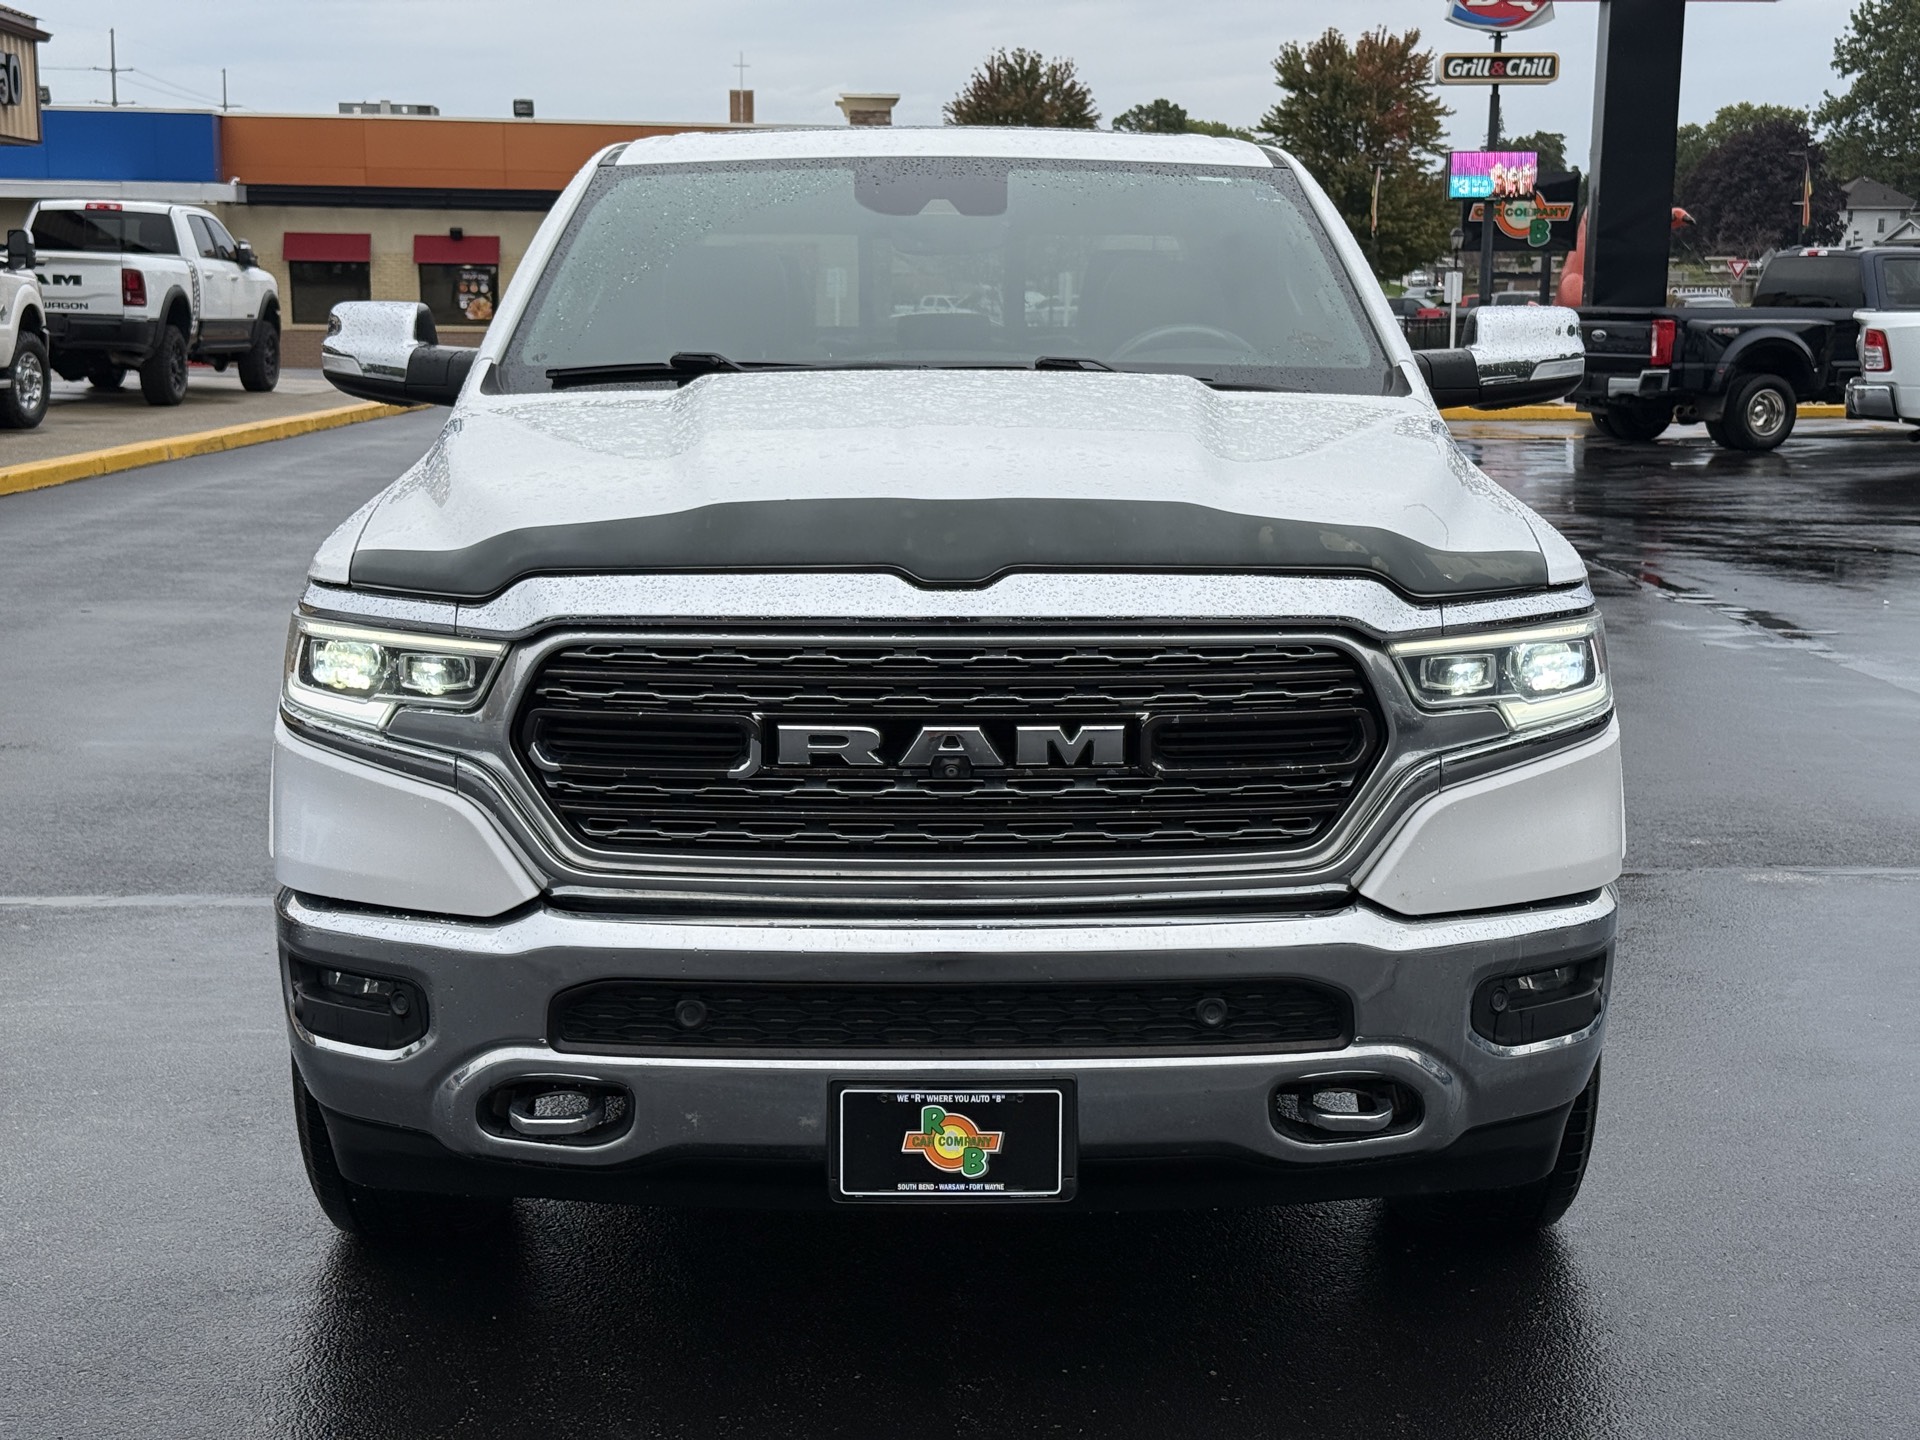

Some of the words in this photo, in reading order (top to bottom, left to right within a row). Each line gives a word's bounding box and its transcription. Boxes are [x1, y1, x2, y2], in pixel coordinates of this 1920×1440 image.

[1474, 207, 1502, 217] CR
[1530, 218, 1549, 245] B
[35, 273, 82, 286] AM
[777, 725, 1125, 767] RAM
[897, 1094, 909, 1103] WE
[910, 1093, 925, 1102] "R"
[926, 1094, 953, 1103] WHERE
[954, 1094, 969, 1102] YOU
[970, 1094, 990, 1103] AUTO
[991, 1094, 1006, 1103] "B"
[923, 1107, 945, 1135] R
[938, 1136, 992, 1146] COMPANY
[963, 1147, 986, 1175] B
[897, 1183, 917, 1191] SOUTH
[918, 1183, 935, 1191] BEND
[939, 1183, 966, 1191] WARSAW
[969, 1183, 984, 1191] FORT
[984, 1183, 1005, 1191] WAYNE
